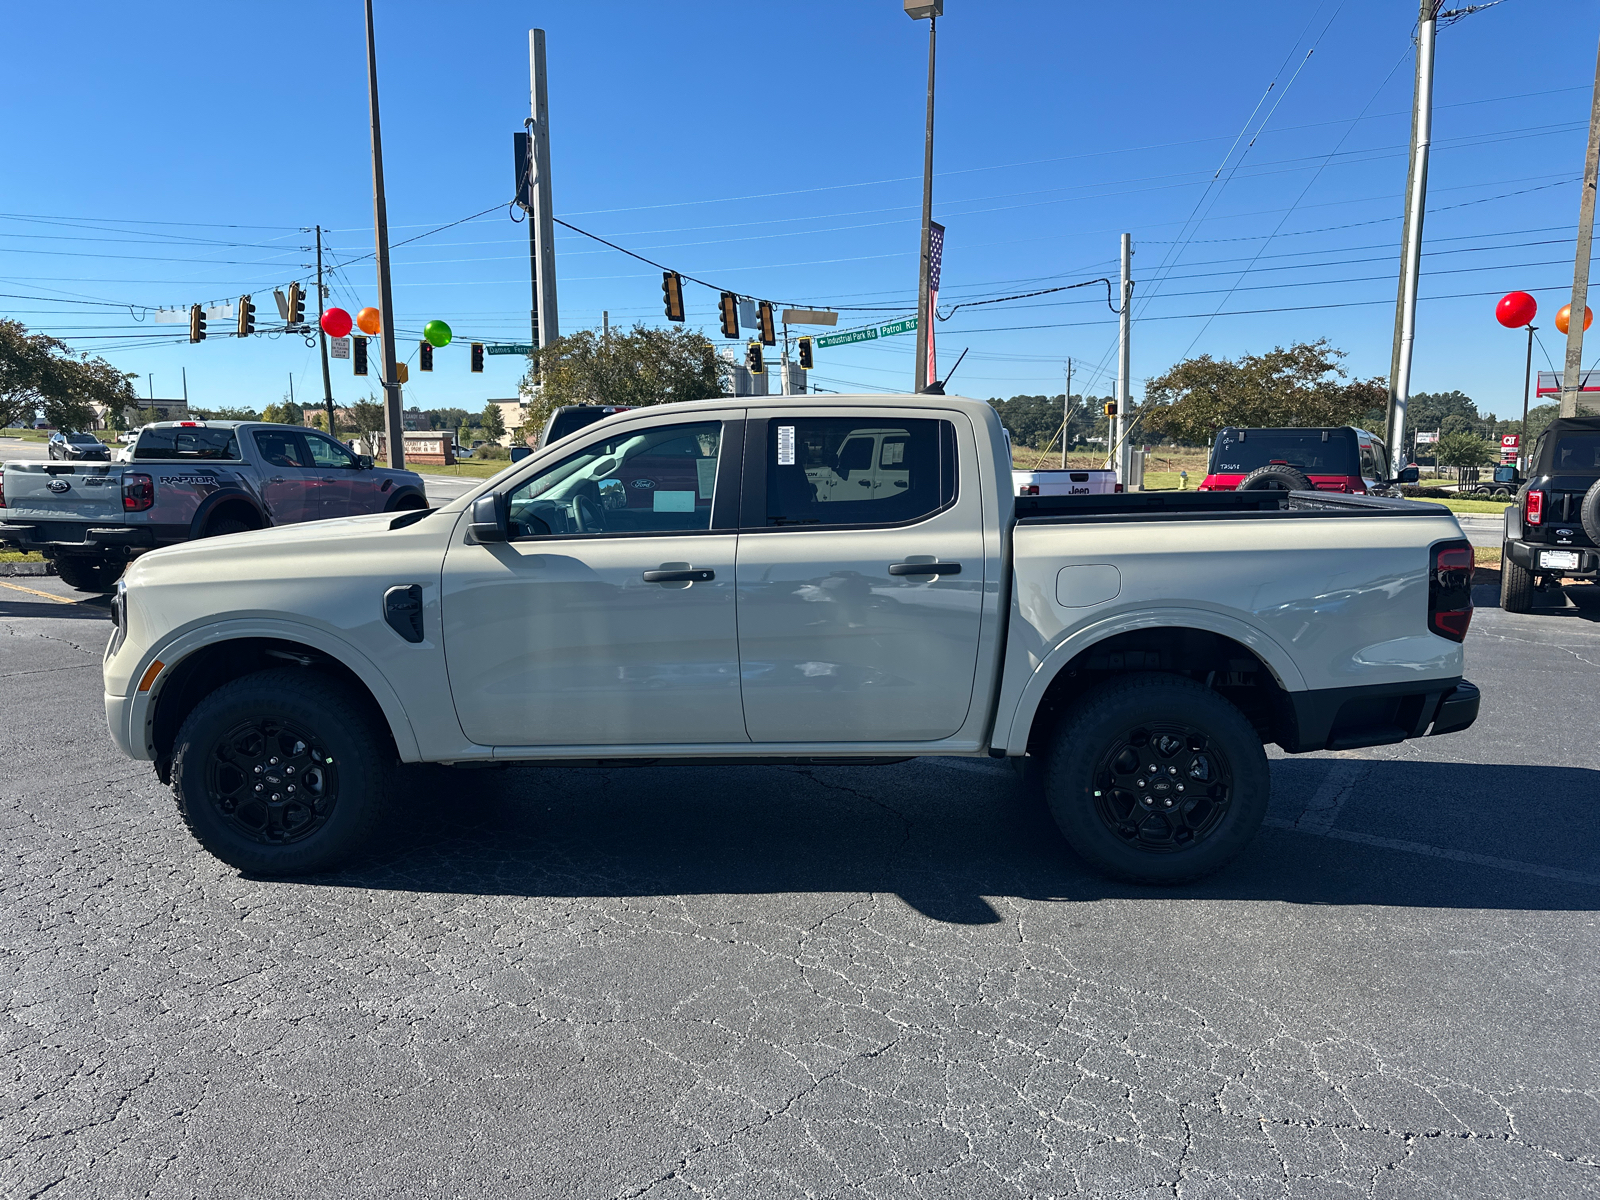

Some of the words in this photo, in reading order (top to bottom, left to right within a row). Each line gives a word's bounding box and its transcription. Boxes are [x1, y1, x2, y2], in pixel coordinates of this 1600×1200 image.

[882, 323, 902, 334] Patrol
[905, 320, 915, 329] Rd
[826, 334, 852, 345] Industrial
[852, 331, 866, 341] Park
[867, 330, 875, 338] Rd
[490, 346, 511, 354] Dames
[514, 346, 530, 354] Ferry
[1503, 436, 1516, 446] QT
[159, 475, 220, 487] RAPTOR
[633, 480, 652, 488] Ford
